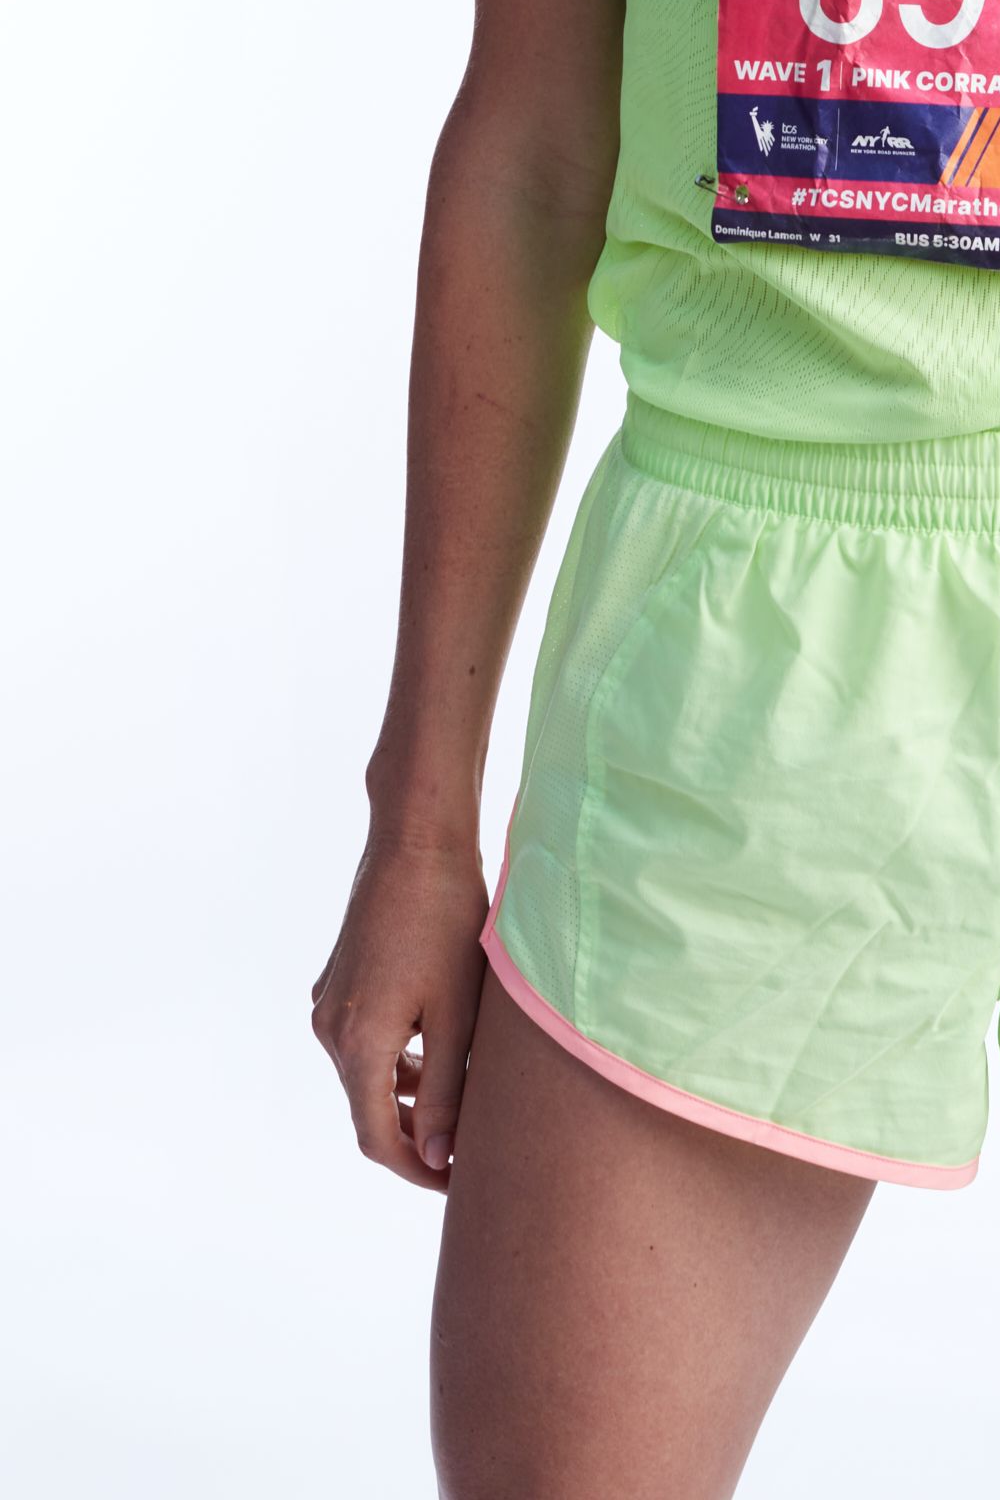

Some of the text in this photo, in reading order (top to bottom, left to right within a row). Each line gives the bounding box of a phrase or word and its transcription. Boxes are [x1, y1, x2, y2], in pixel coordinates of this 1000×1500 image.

[734, 60, 807, 84] WAVE
[816, 59, 832, 92] 1
[852, 67, 911, 90] PINK
[782, 122, 797, 134] tcs
[781, 143, 816, 151] MARATHON
[715, 224, 841, 243] Dominique Lamon W 31
[895, 232, 1000, 252] BUS 5:30AM
